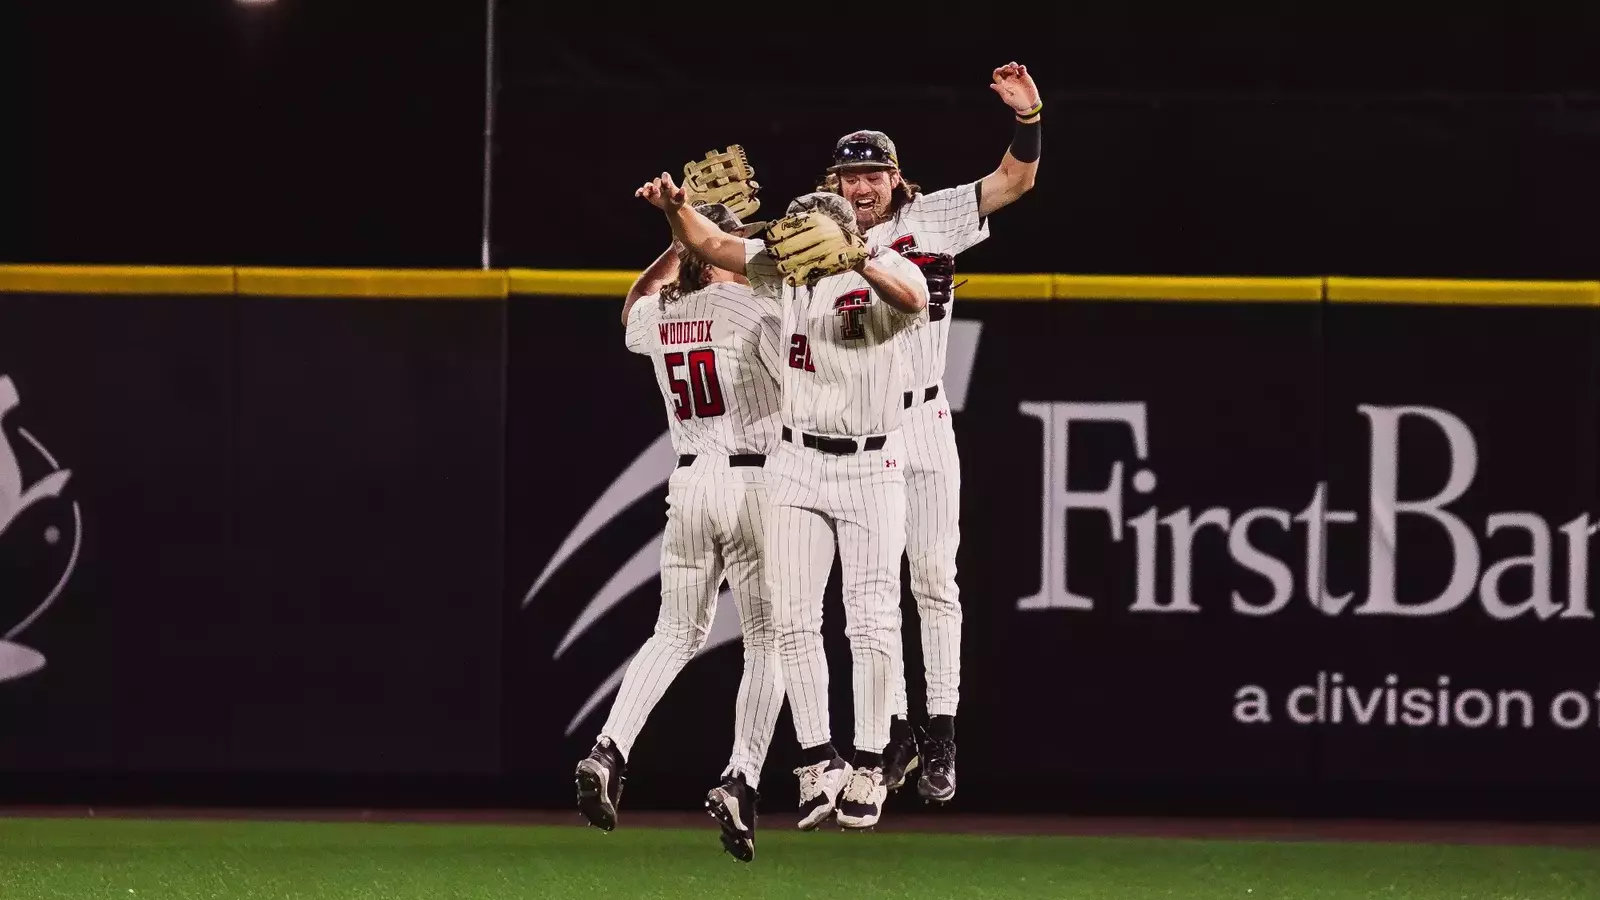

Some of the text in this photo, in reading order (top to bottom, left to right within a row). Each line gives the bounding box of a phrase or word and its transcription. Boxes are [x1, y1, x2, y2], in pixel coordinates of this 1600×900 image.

[658, 320, 714, 345] WOODCOX
[664, 348, 726, 421] 50
[1233, 671, 1600, 729] a division o
